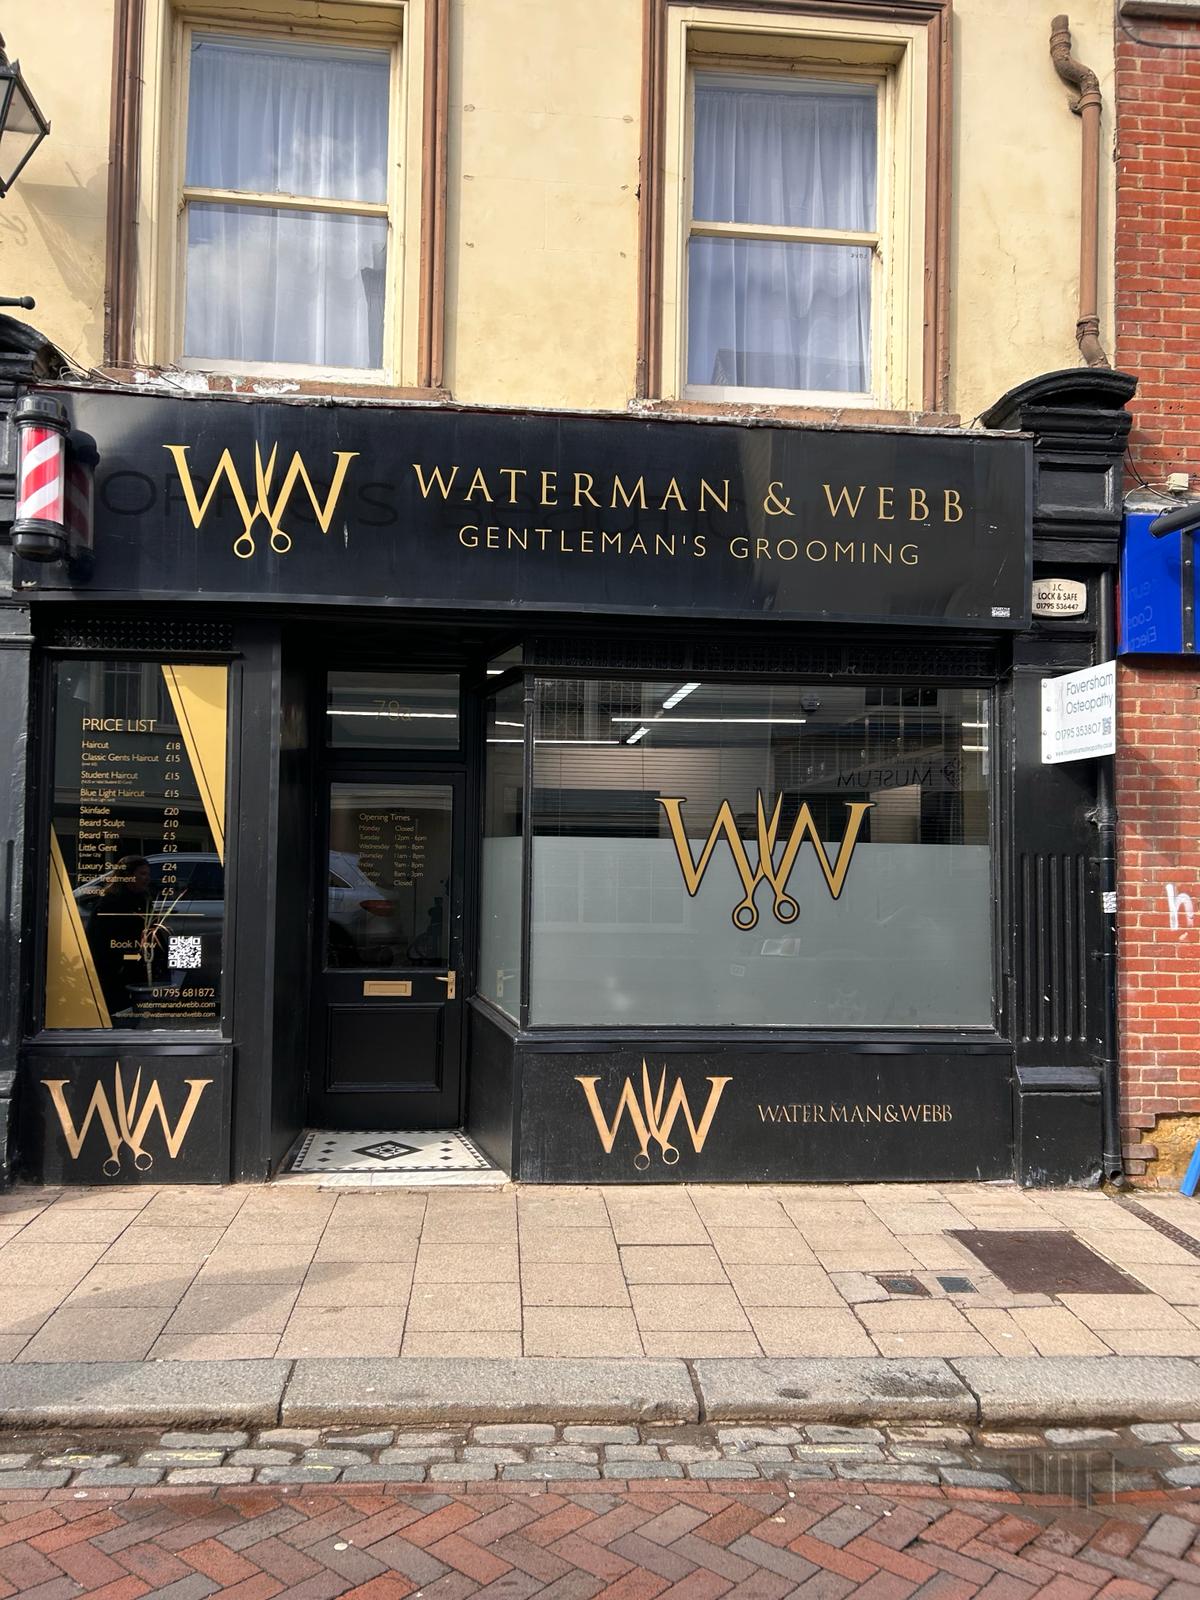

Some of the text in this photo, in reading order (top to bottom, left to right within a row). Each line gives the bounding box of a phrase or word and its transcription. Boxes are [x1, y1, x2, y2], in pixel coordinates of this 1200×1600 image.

[412, 463, 730, 513] WATERMAN
[763, 481, 796, 517] &
[823, 483, 964, 523] WEBB
[459, 525, 919, 565] GENTLEMAN'S GROOMING
[1063, 593, 1078, 601] SAFE
[1066, 673, 1114, 696] Faversham
[1066, 692, 1114, 715] Osteopathy
[82, 718, 157, 732] PRICE LIST
[1055, 721, 1101, 741] 01795 353807
[82, 740, 180, 750] Haircut £18
[82, 752, 180, 762] Classic Gents Haircut £15
[81, 770, 180, 780] Student Haircut £15
[80, 788, 180, 798] Blue Light Haircut £15
[80, 806, 180, 816] Skinfade £20
[360, 812, 388, 822] Opening
[80, 818, 178, 828] Beard Sculpt £10
[79, 831, 100, 839] Beard
[78, 844, 178, 852] Little Gent £12
[78, 862, 177, 871] Luxury Shave £24
[162, 876, 176, 884] £10
[110, 940, 132, 949] Book
[152, 988, 215, 998] 01795 681872
[757, 1103, 953, 1123] WATERMAN&WEBB
